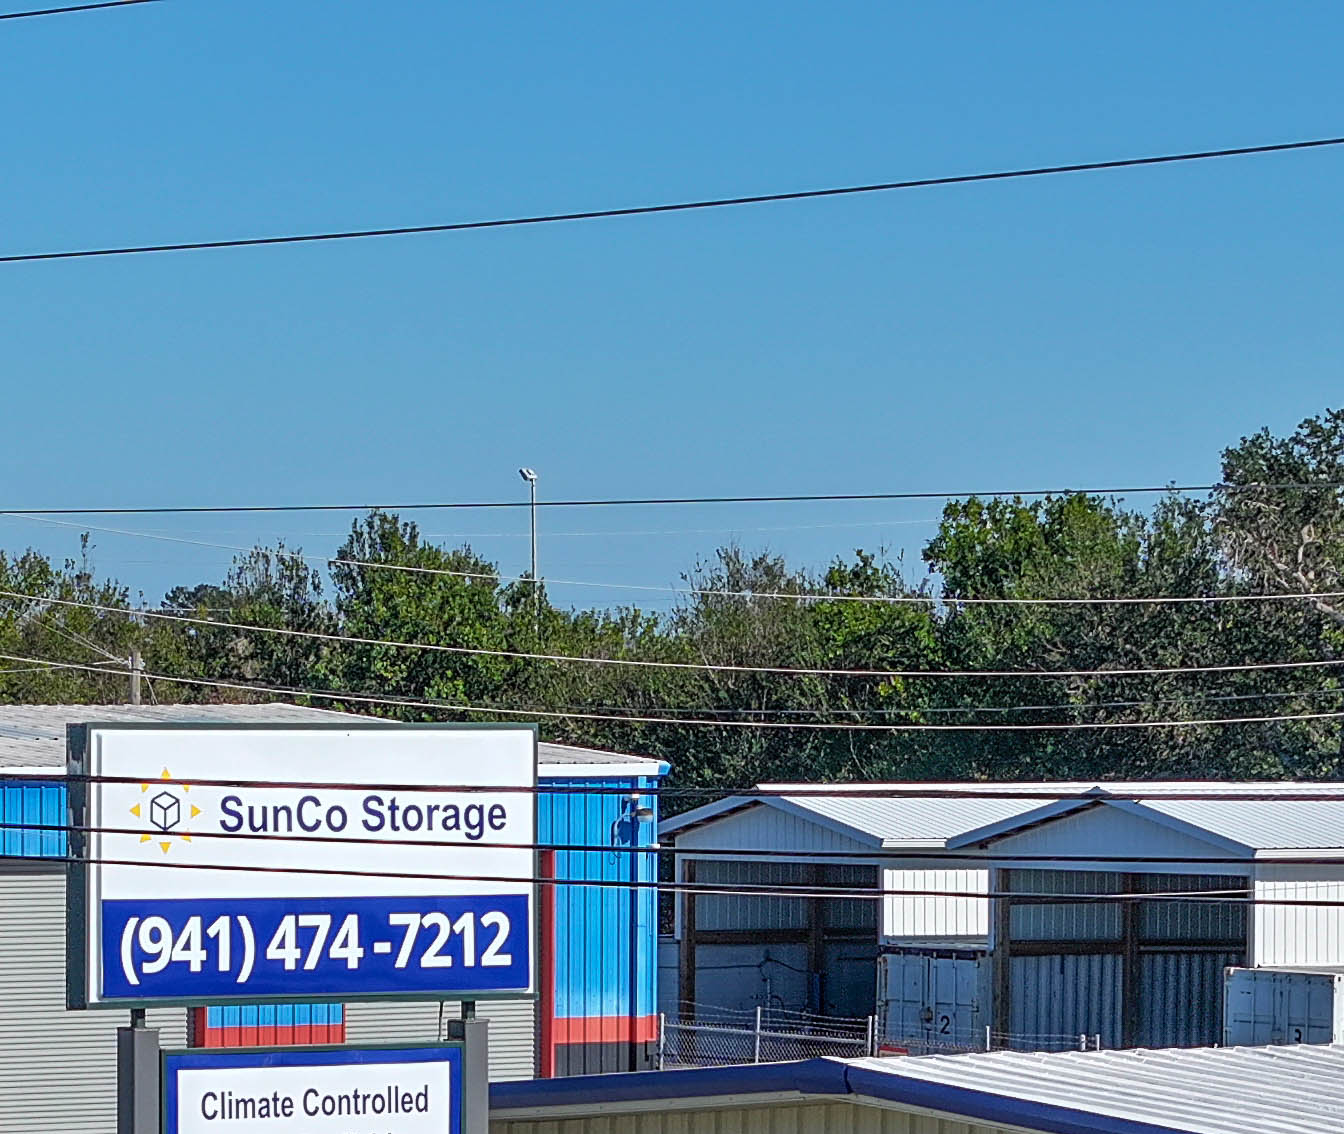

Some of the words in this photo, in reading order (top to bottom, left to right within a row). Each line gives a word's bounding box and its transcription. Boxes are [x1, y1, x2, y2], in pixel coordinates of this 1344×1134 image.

[219, 794, 349, 833] SunCo
[361, 794, 508, 841] Storage
[120, 914, 256, 986] (941)
[940, 1015, 951, 1035] 2
[200, 1090, 295, 1120] Climate
[302, 1084, 429, 1117] Controlled
